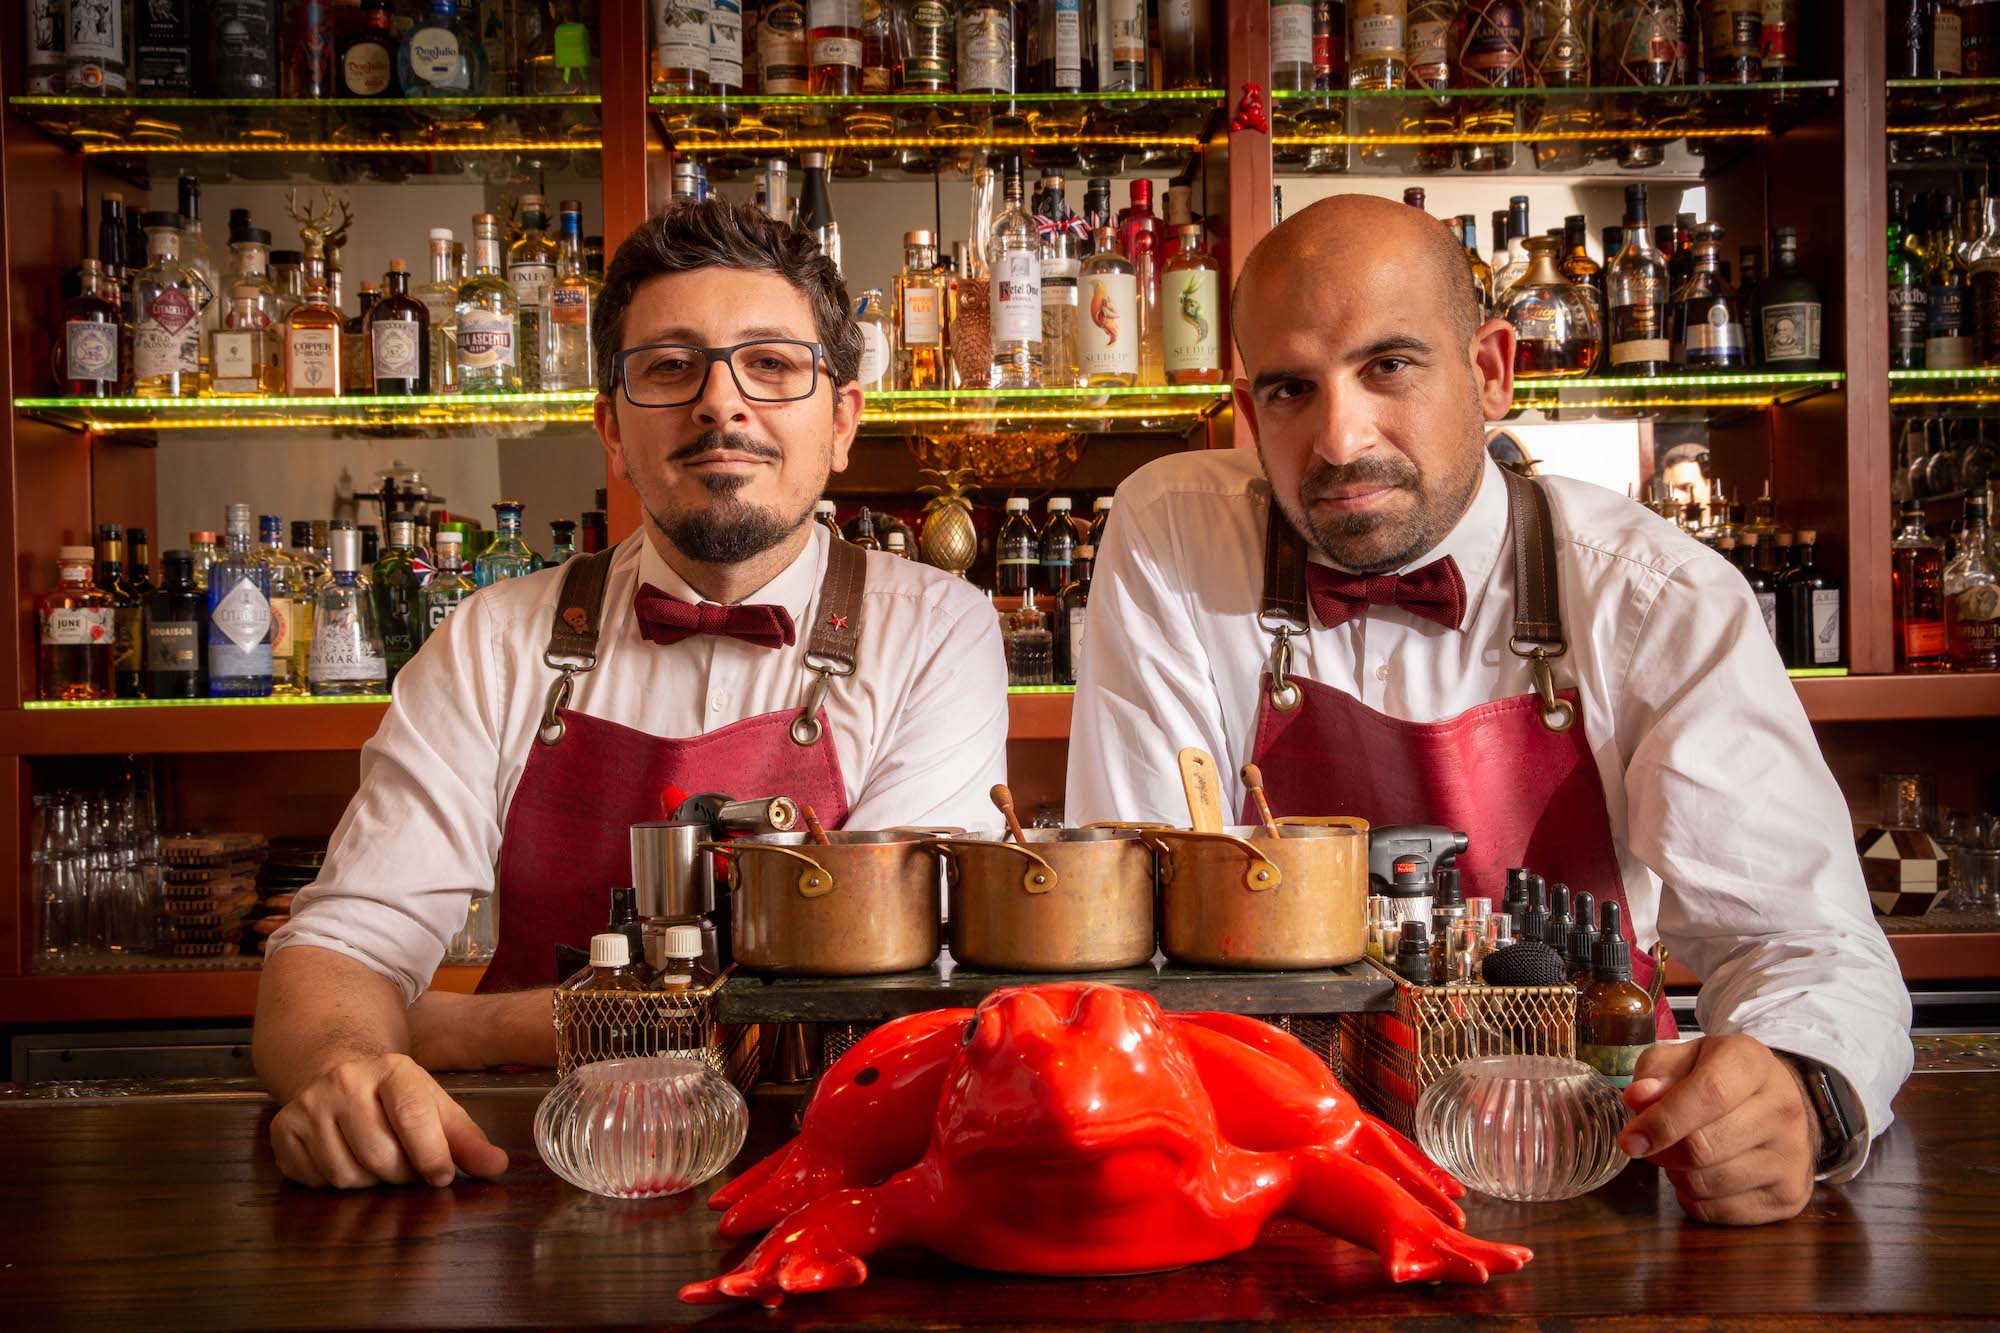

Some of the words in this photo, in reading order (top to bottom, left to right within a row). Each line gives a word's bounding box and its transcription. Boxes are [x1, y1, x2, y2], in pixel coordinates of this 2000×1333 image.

[513, 272, 546, 281] OXLEY
[1026, 283, 1040, 296] One
[152, 304, 190, 316] CITADELLE
[471, 333, 508, 346] ASCENTI
[293, 343, 332, 351] COPPER
[57, 619, 81, 629] JUNE
